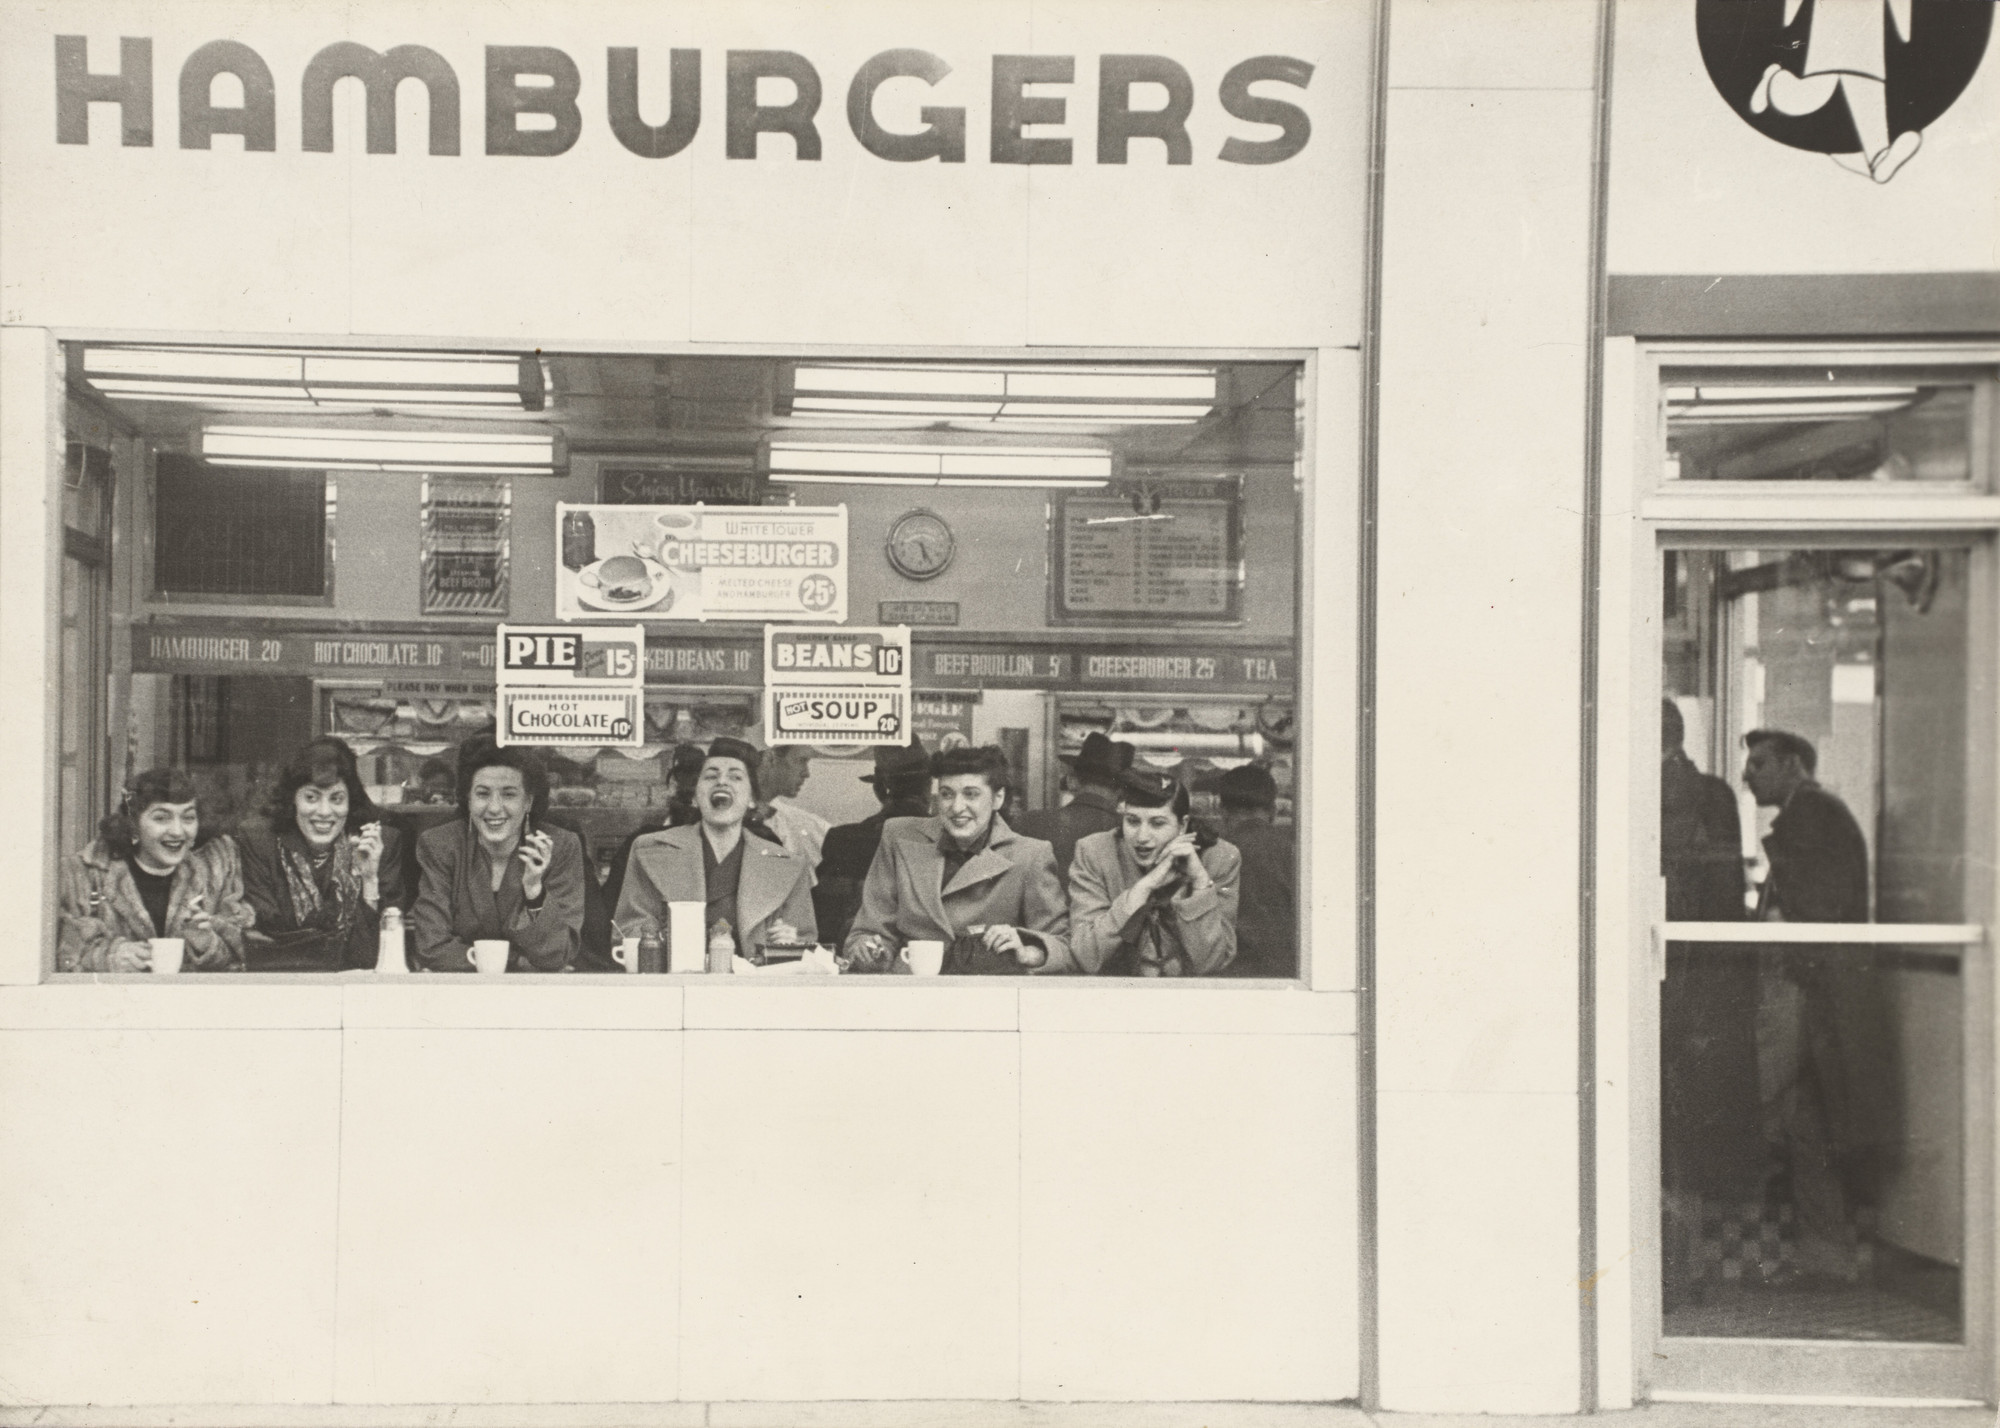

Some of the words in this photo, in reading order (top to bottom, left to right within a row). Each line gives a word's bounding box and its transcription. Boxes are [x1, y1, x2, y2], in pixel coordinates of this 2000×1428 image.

[56, 34, 1315, 166] HAMBURGERS
[678, 473, 760, 499] Yourself
[725, 521, 769, 535] WHITE
[771, 521, 815, 535] TOWER
[661, 541, 834, 566] CHEESEBURGER
[462, 578, 492, 588] BROTH
[717, 590, 736, 599] AND
[737, 590, 791, 599] HAMBURGER
[718, 578, 756, 588] MELTED
[757, 578, 794, 588] CHEESE
[150, 636, 249, 661] HAMBURGER
[315, 641, 341, 663] HOT
[342, 642, 418, 665] CHOCOLATE
[507, 636, 576, 666] PIE
[644, 649, 674, 670] KED
[677, 649, 725, 671] BEANS
[776, 643, 873, 668] BEANS
[935, 653, 969, 675] BEEF
[971, 654, 1034, 677] BOUILLON
[1089, 655, 1191, 679] CHEESEBURGER
[1243, 657, 1278, 680] TEA
[387, 683, 420, 693] PLEASE
[423, 683, 441, 693] PAY
[444, 684, 468, 694] WHEN
[472, 684, 497, 695] SERV
[518, 710, 609, 727] CHOCOLATE
[548, 703, 579, 711] HOT
[786, 702, 807, 715] HOT
[810, 701, 878, 720] SOUP
